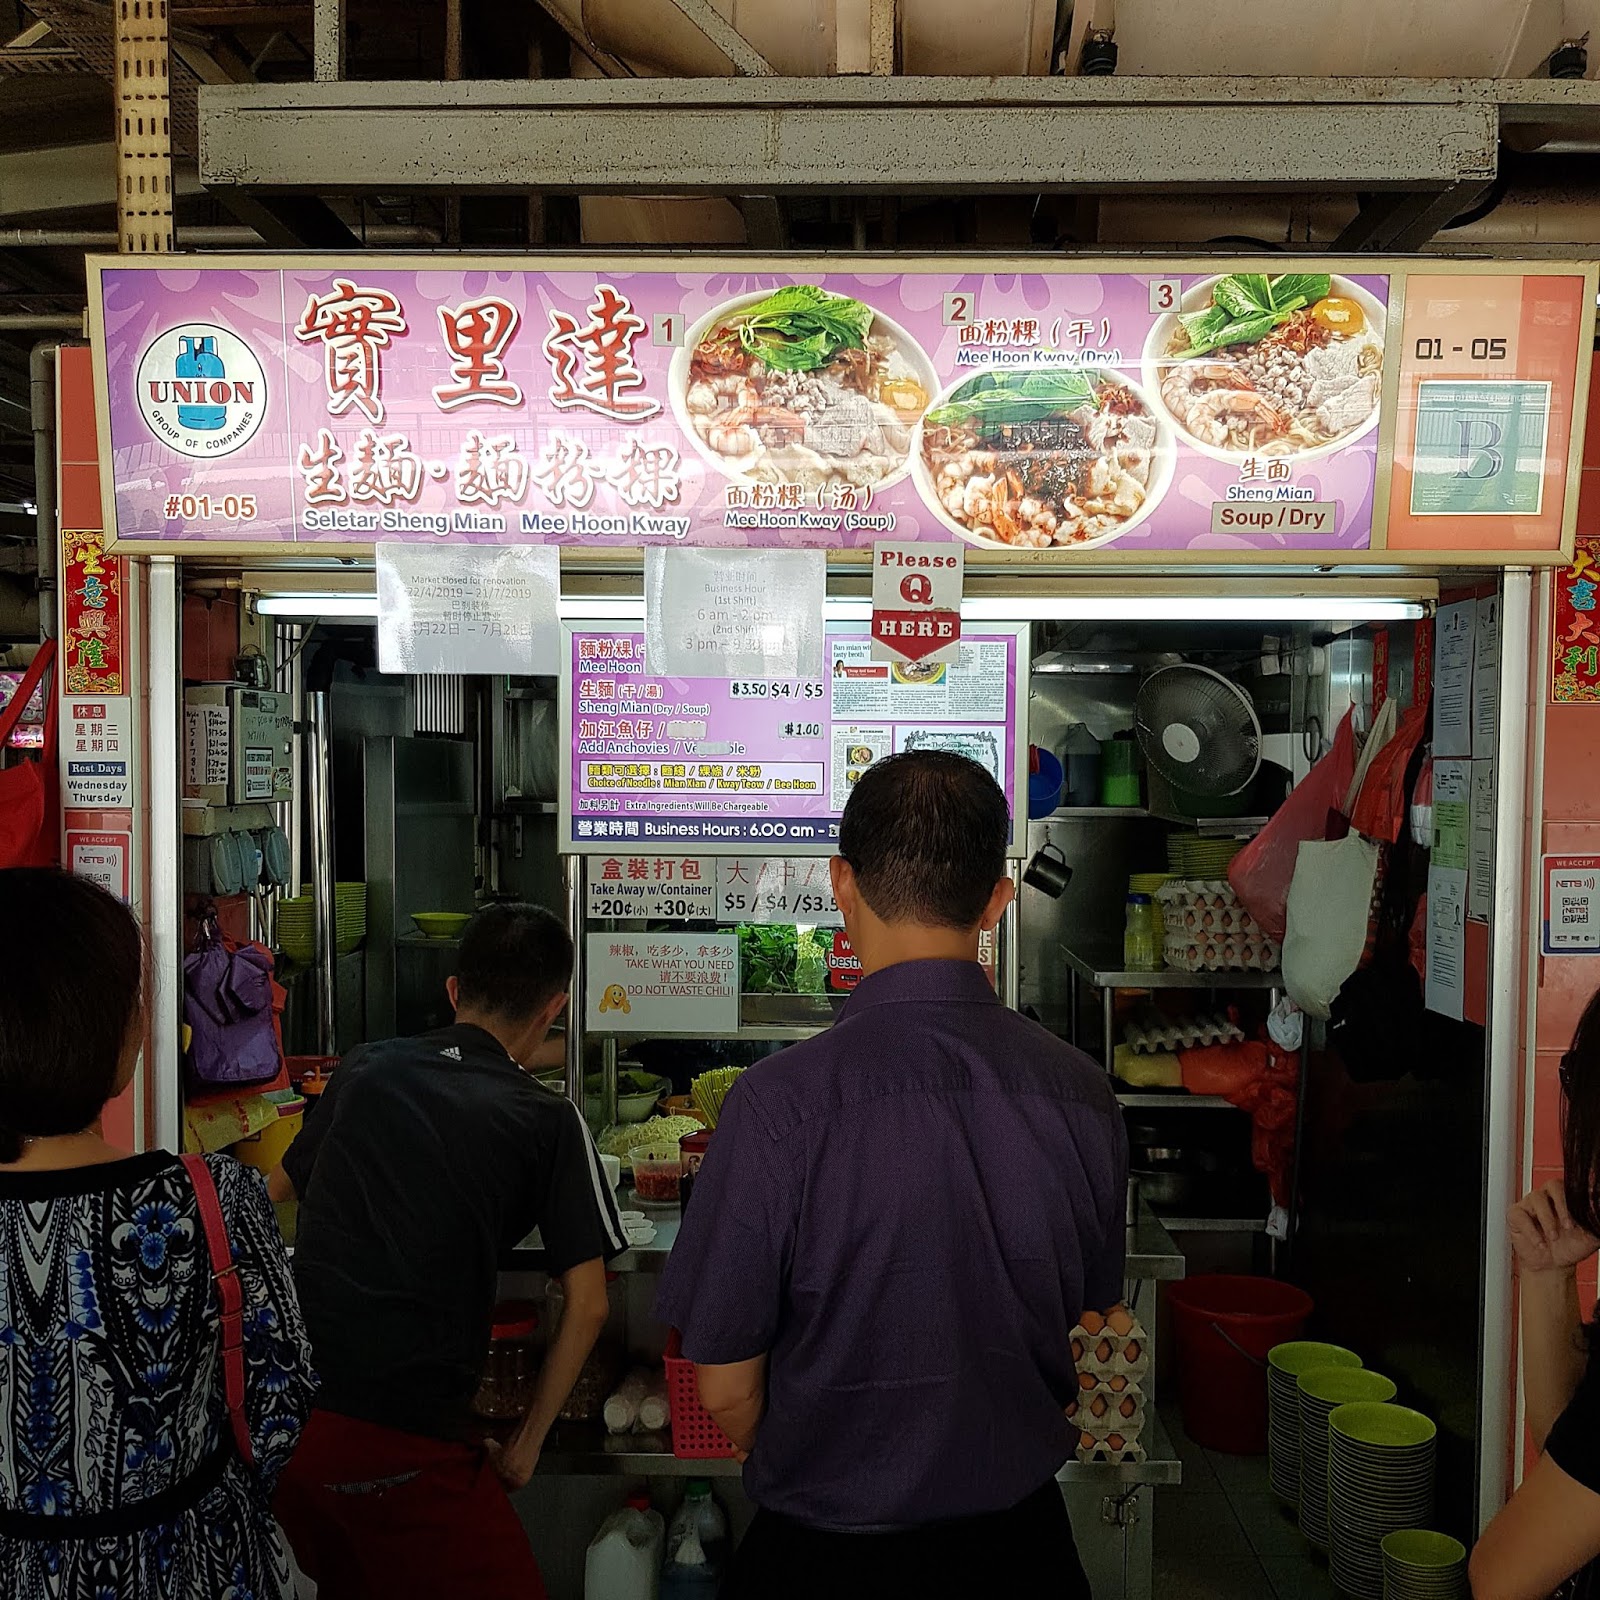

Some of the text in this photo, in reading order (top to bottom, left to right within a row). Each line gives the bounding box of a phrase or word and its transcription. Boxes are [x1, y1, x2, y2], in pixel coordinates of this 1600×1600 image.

[1158, 284, 1173, 309] 3
[951, 297, 967, 321] 2
[661, 318, 673, 342] 1
[1415, 338, 1507, 360] 01 05
[957, 350, 988, 363] Mee
[992, 350, 1029, 363] Hoon
[1034, 350, 1075, 365] Kway
[148, 381, 254, 404] UNION
[152, 410, 253, 449] GROUP OF COMPANIES
[1450, 420, 1503, 480] B
[1240, 457, 1291, 480] 生面
[1228, 486, 1313, 501] Sheng Mian
[165, 496, 256, 519] #01-05
[305, 510, 687, 536] Seletar Sheng Mian Mee Hoon Kway
[726, 513, 895, 529] Mee Hoon Kway (Soup)
[1221, 508, 1273, 529] Soup
[1290, 508, 1326, 529] Dry
[880, 551, 957, 568] Please
[411, 576, 526, 586] Market closed for renovation
[407, 587, 531, 599] 22/4/2019 21/7/2019
[704, 584, 766, 594] Business Hour
[900, 573, 933, 605] Q
[715, 596, 757, 606] (1st Shift)
[697, 609, 705, 620] 6
[709, 612, 728, 620] am
[742, 610, 749, 620] 2
[713, 625, 732, 635] (2nd
[880, 620, 952, 637] HERE
[580, 641, 632, 657] 麵粉粿
[686, 638, 693, 649] 3
[698, 641, 718, 651] pm
[580, 661, 640, 672] Mee Hoon
[581, 681, 614, 697] 生麵
[732, 683, 767, 696] $3.50
[771, 682, 790, 698] $4
[804, 682, 823, 698] $5
[77, 706, 103, 718] 休息
[580, 701, 710, 714] Sheng Mian (Dry Soup)
[75, 723, 118, 736] 星期三
[580, 721, 653, 738] 加江魚仔
[784, 722, 819, 735] $1.00
[75, 739, 118, 752] 星期四
[580, 742, 668, 753] Add Anchovies
[72, 763, 122, 775] Rest Days
[67, 781, 127, 791] Wednesday
[588, 778, 816, 791] Choice of Noodle Mian Xian Kway Teow Bee Hoon
[73, 793, 122, 804] Thursday
[626, 801, 769, 813] Extra Ingredients Will Be Chargeable
[578, 820, 639, 836] 營業時間
[645, 821, 699, 836] Business
[749, 823, 786, 837] 6.00
[790, 826, 814, 837] am
[79, 836, 117, 844] WE ACCEPT
[79, 856, 104, 864] NETS
[601, 858, 702, 880] 盒裝打包
[726, 860, 749, 884] 大
[776, 861, 796, 886] 中
[590, 883, 712, 898] Take Away w/Container
[1556, 880, 1582, 888] NETS
[725, 892, 746, 911] $5
[766, 892, 787, 912] $4
[625, 959, 735, 970] TAKE WHAT YOU NEED
[628, 984, 643, 995] DO
[646, 985, 666, 995] NOT
[669, 985, 703, 996] WASTE
